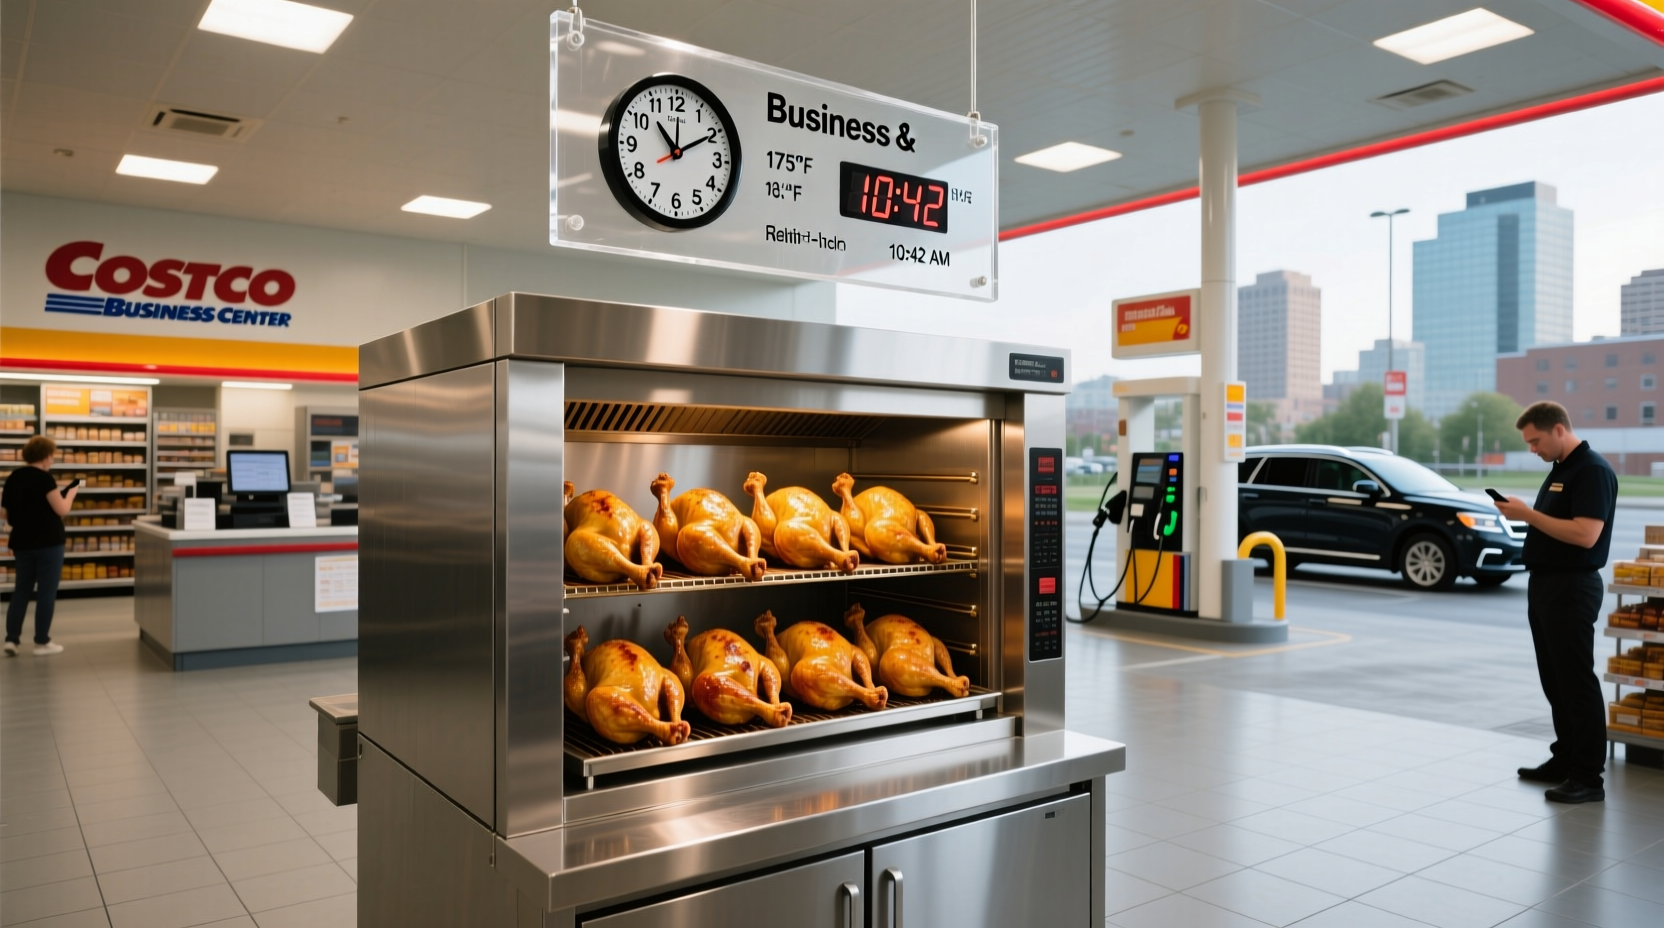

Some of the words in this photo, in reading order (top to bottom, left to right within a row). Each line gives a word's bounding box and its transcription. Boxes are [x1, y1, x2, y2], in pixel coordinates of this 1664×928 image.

[649, 97, 661, 113] 11
[667, 95, 685, 112] 12
[633, 112, 648, 130] 10
[695, 108, 701, 123] 1
[767, 91, 891, 147] Business
[895, 122, 916, 153] &
[626, 135, 637, 152] 9
[706, 127, 717, 143] 2
[712, 151, 722, 168] 3
[766, 150, 814, 174] 175°F
[633, 161, 644, 178] 8
[650, 181, 660, 198] 7
[705, 175, 715, 191] 4
[671, 192, 681, 209] 6
[691, 188, 702, 205] 5
[860, 173, 945, 228] 10:42
[888, 243, 927, 264] 10:42
[929, 250, 951, 267] AM
[45, 240, 296, 307] COSTCO
[102, 297, 216, 323] BUSINESS
[217, 306, 292, 328] CENTER
